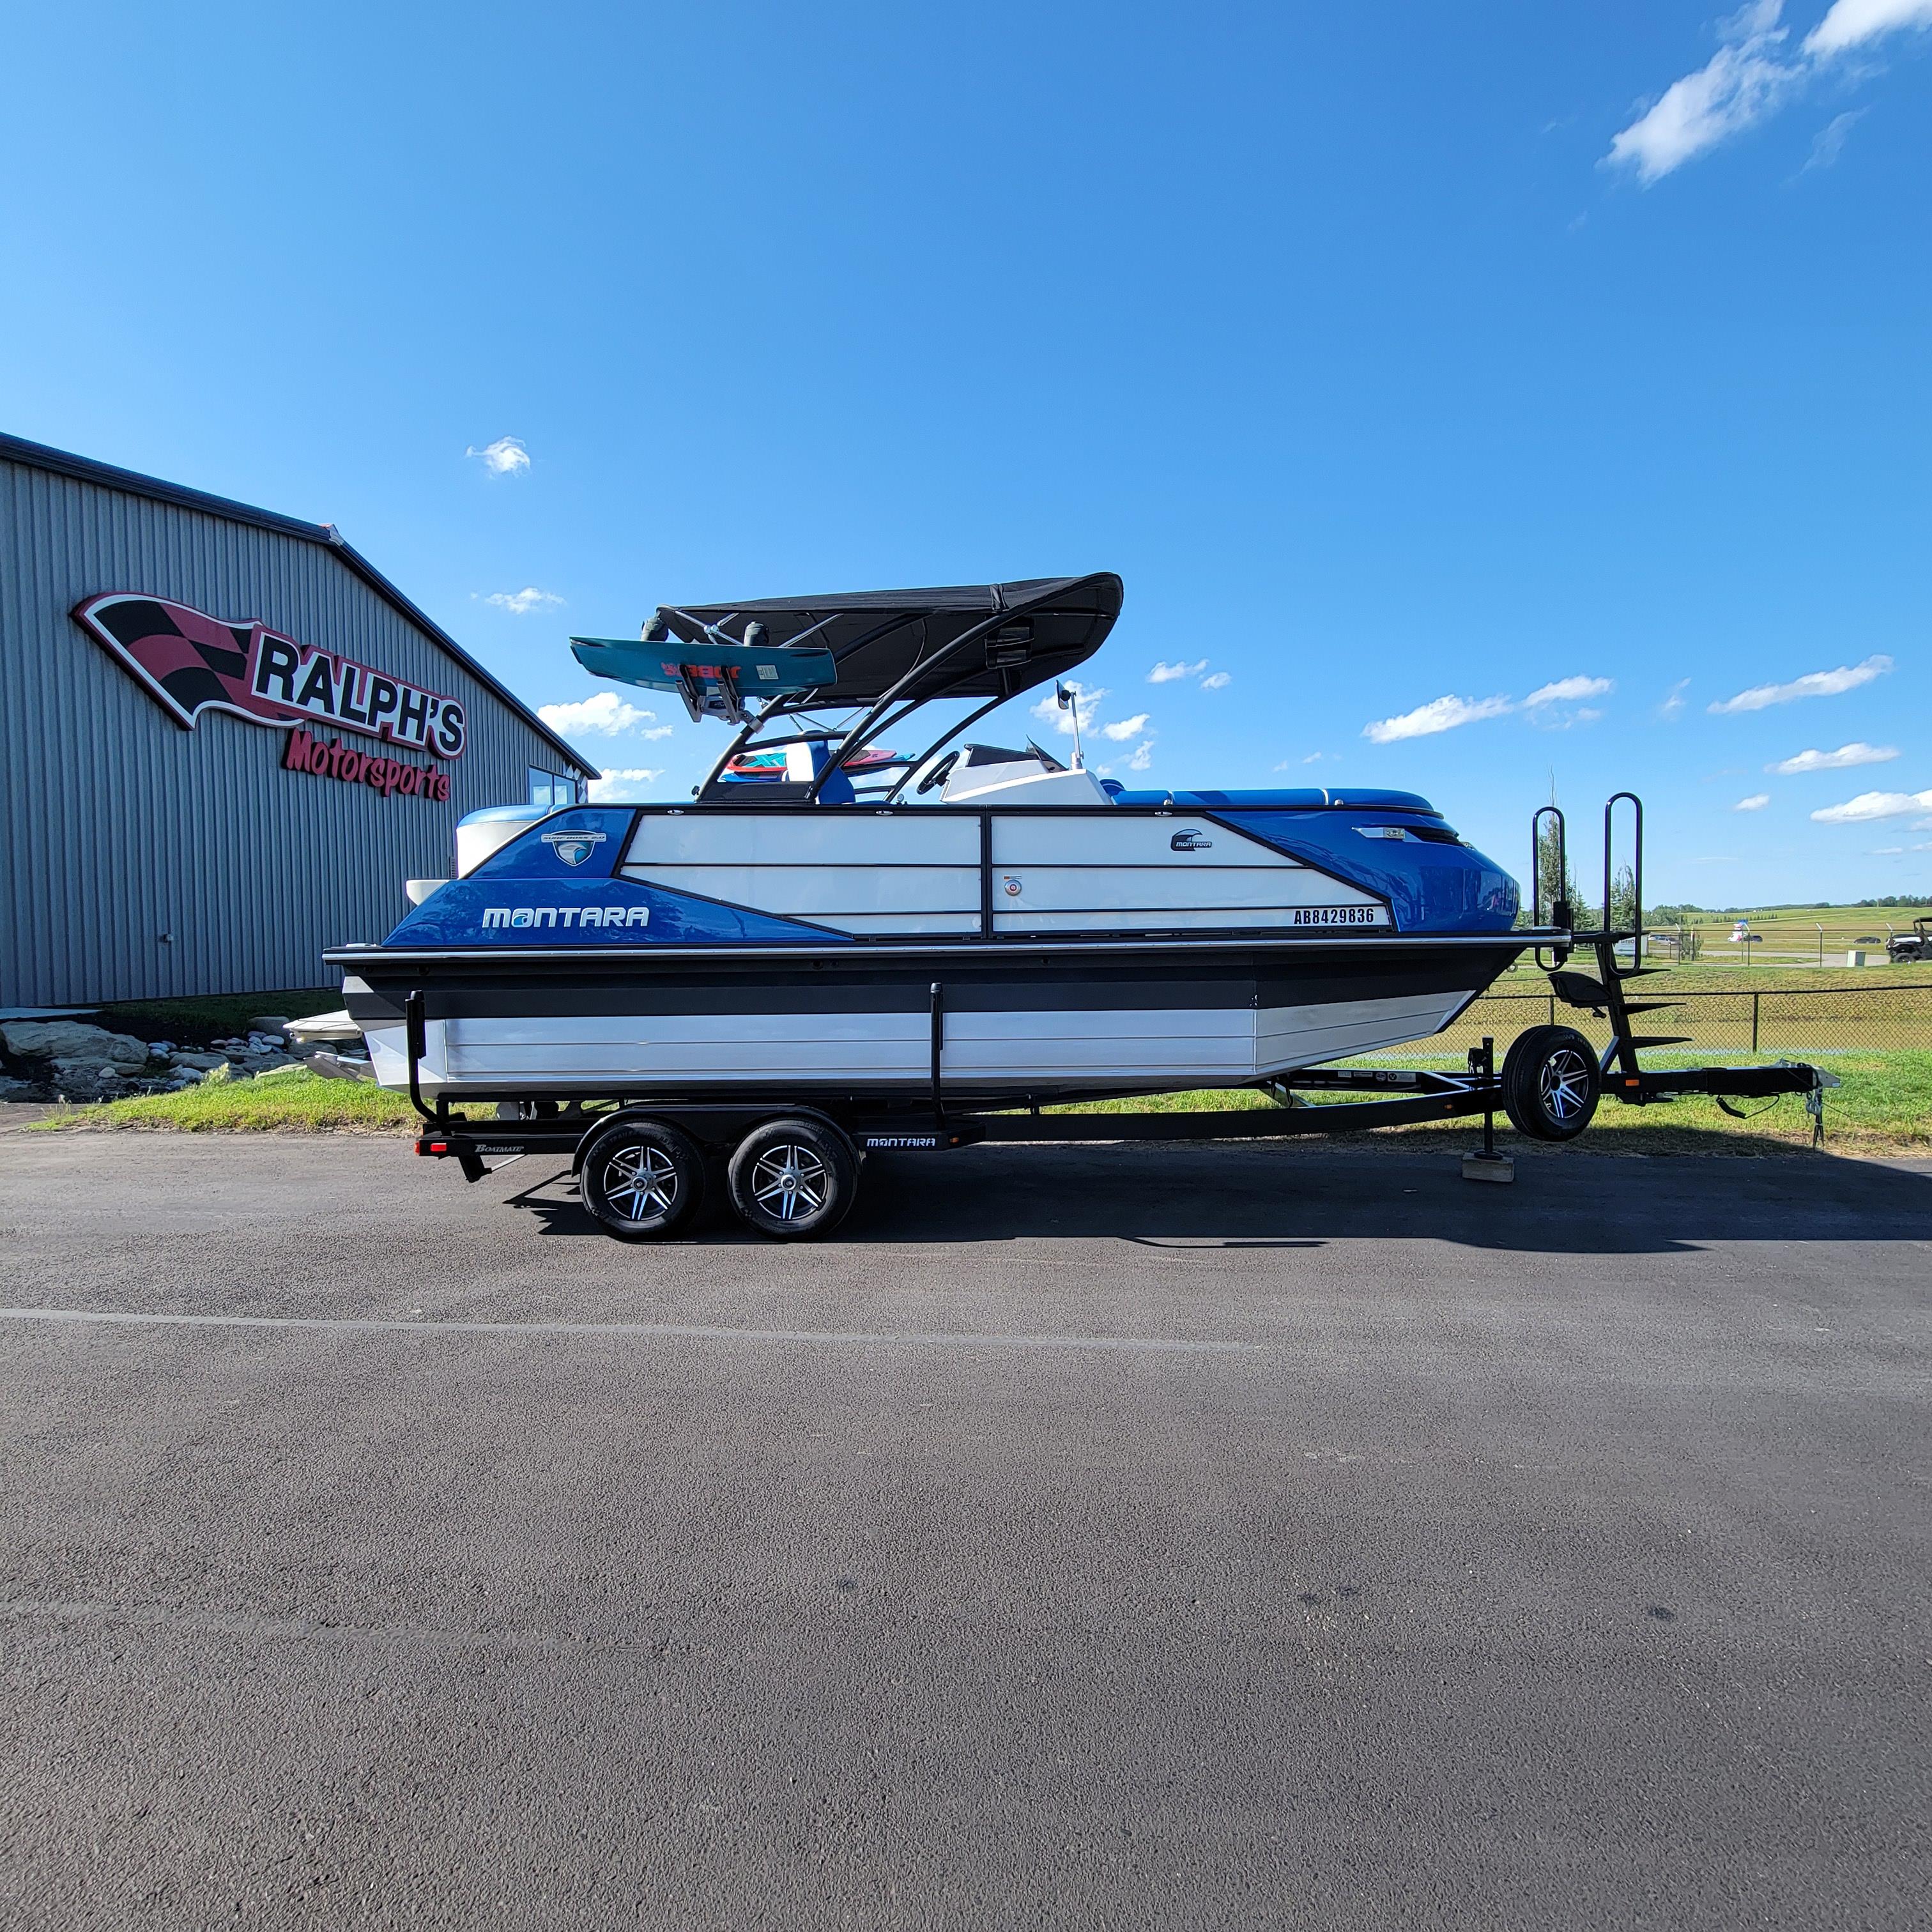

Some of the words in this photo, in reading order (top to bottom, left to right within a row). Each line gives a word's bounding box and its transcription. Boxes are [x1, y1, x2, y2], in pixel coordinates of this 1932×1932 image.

[256, 634, 465, 752] RALPH'S
[286, 726, 450, 801] Motorsports
[482, 907, 650, 928] MONTARA
[1294, 908, 1374, 924] AB8429836
[867, 1138, 936, 1146] MONTARA
